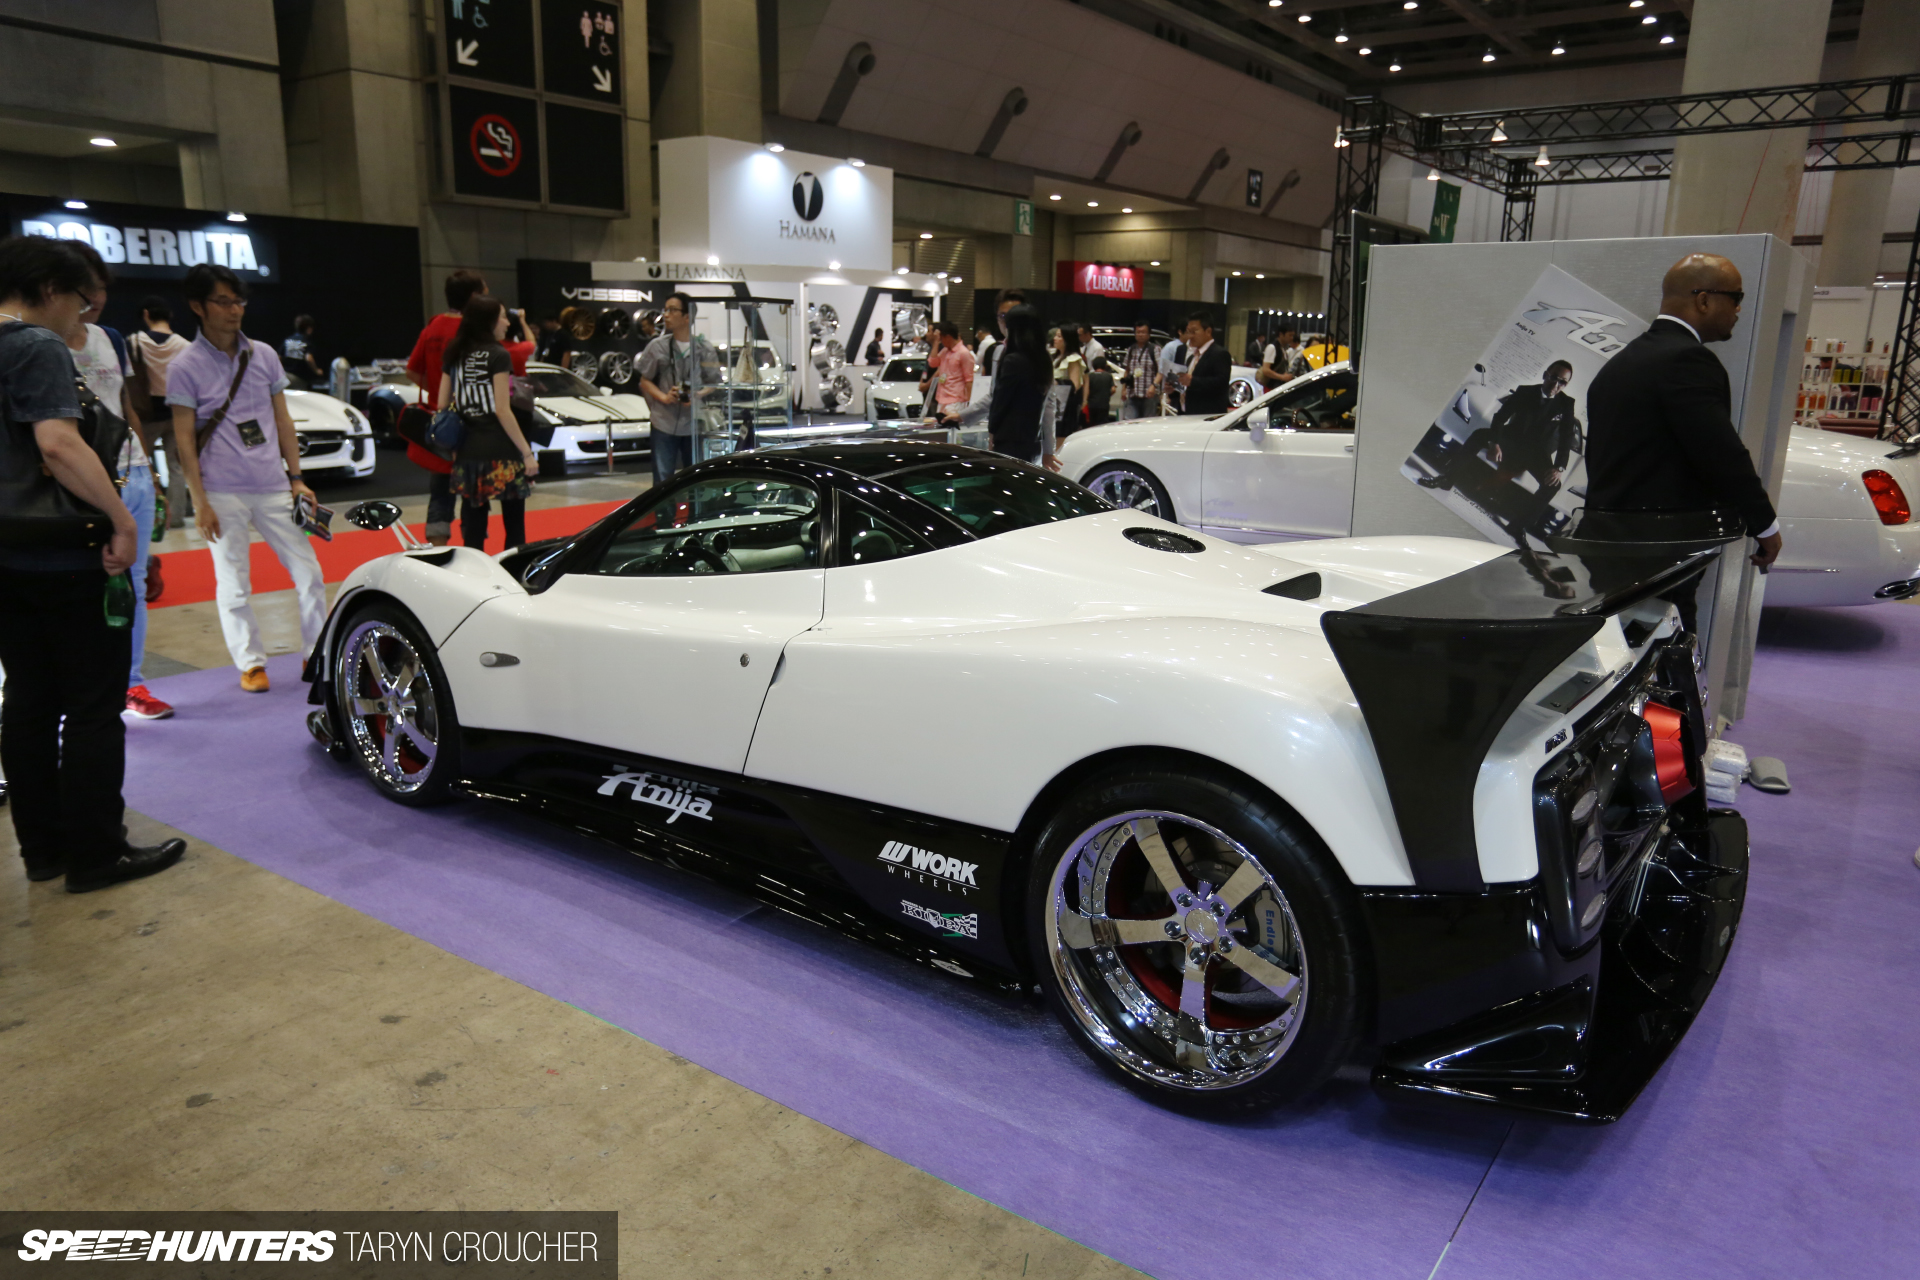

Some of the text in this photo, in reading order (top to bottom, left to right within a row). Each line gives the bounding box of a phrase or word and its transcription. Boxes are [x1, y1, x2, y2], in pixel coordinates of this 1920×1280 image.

[778, 220, 836, 245] HAMANA
[666, 264, 747, 280] HAMANA
[561, 287, 653, 303] VOSSEN
[475, 350, 490, 385] STAY
[887, 864, 967, 896] WHEELS
[911, 846, 979, 886] WORK
